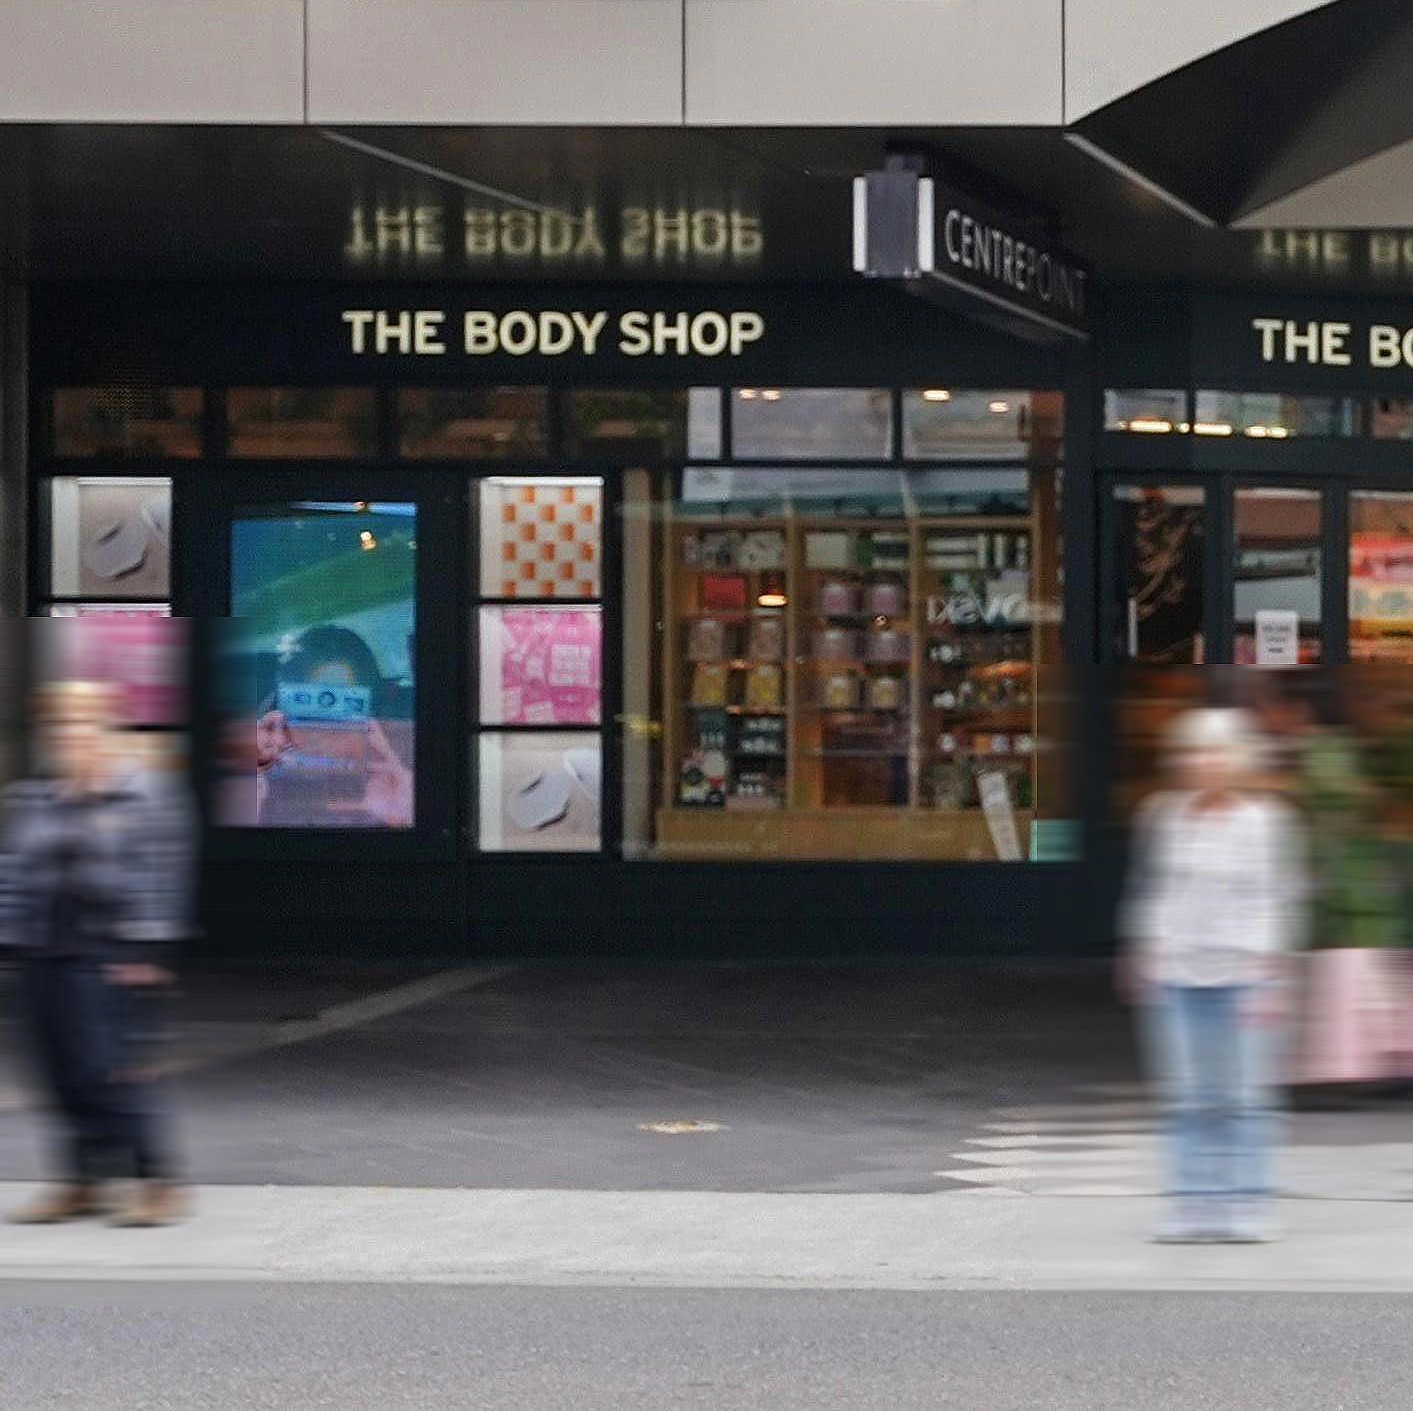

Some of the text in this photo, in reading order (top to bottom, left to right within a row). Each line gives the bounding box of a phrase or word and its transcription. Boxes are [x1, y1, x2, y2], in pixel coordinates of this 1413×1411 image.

[342, 309, 766, 356] THE BODY SHOP
[1252, 317, 1352, 366] THE
